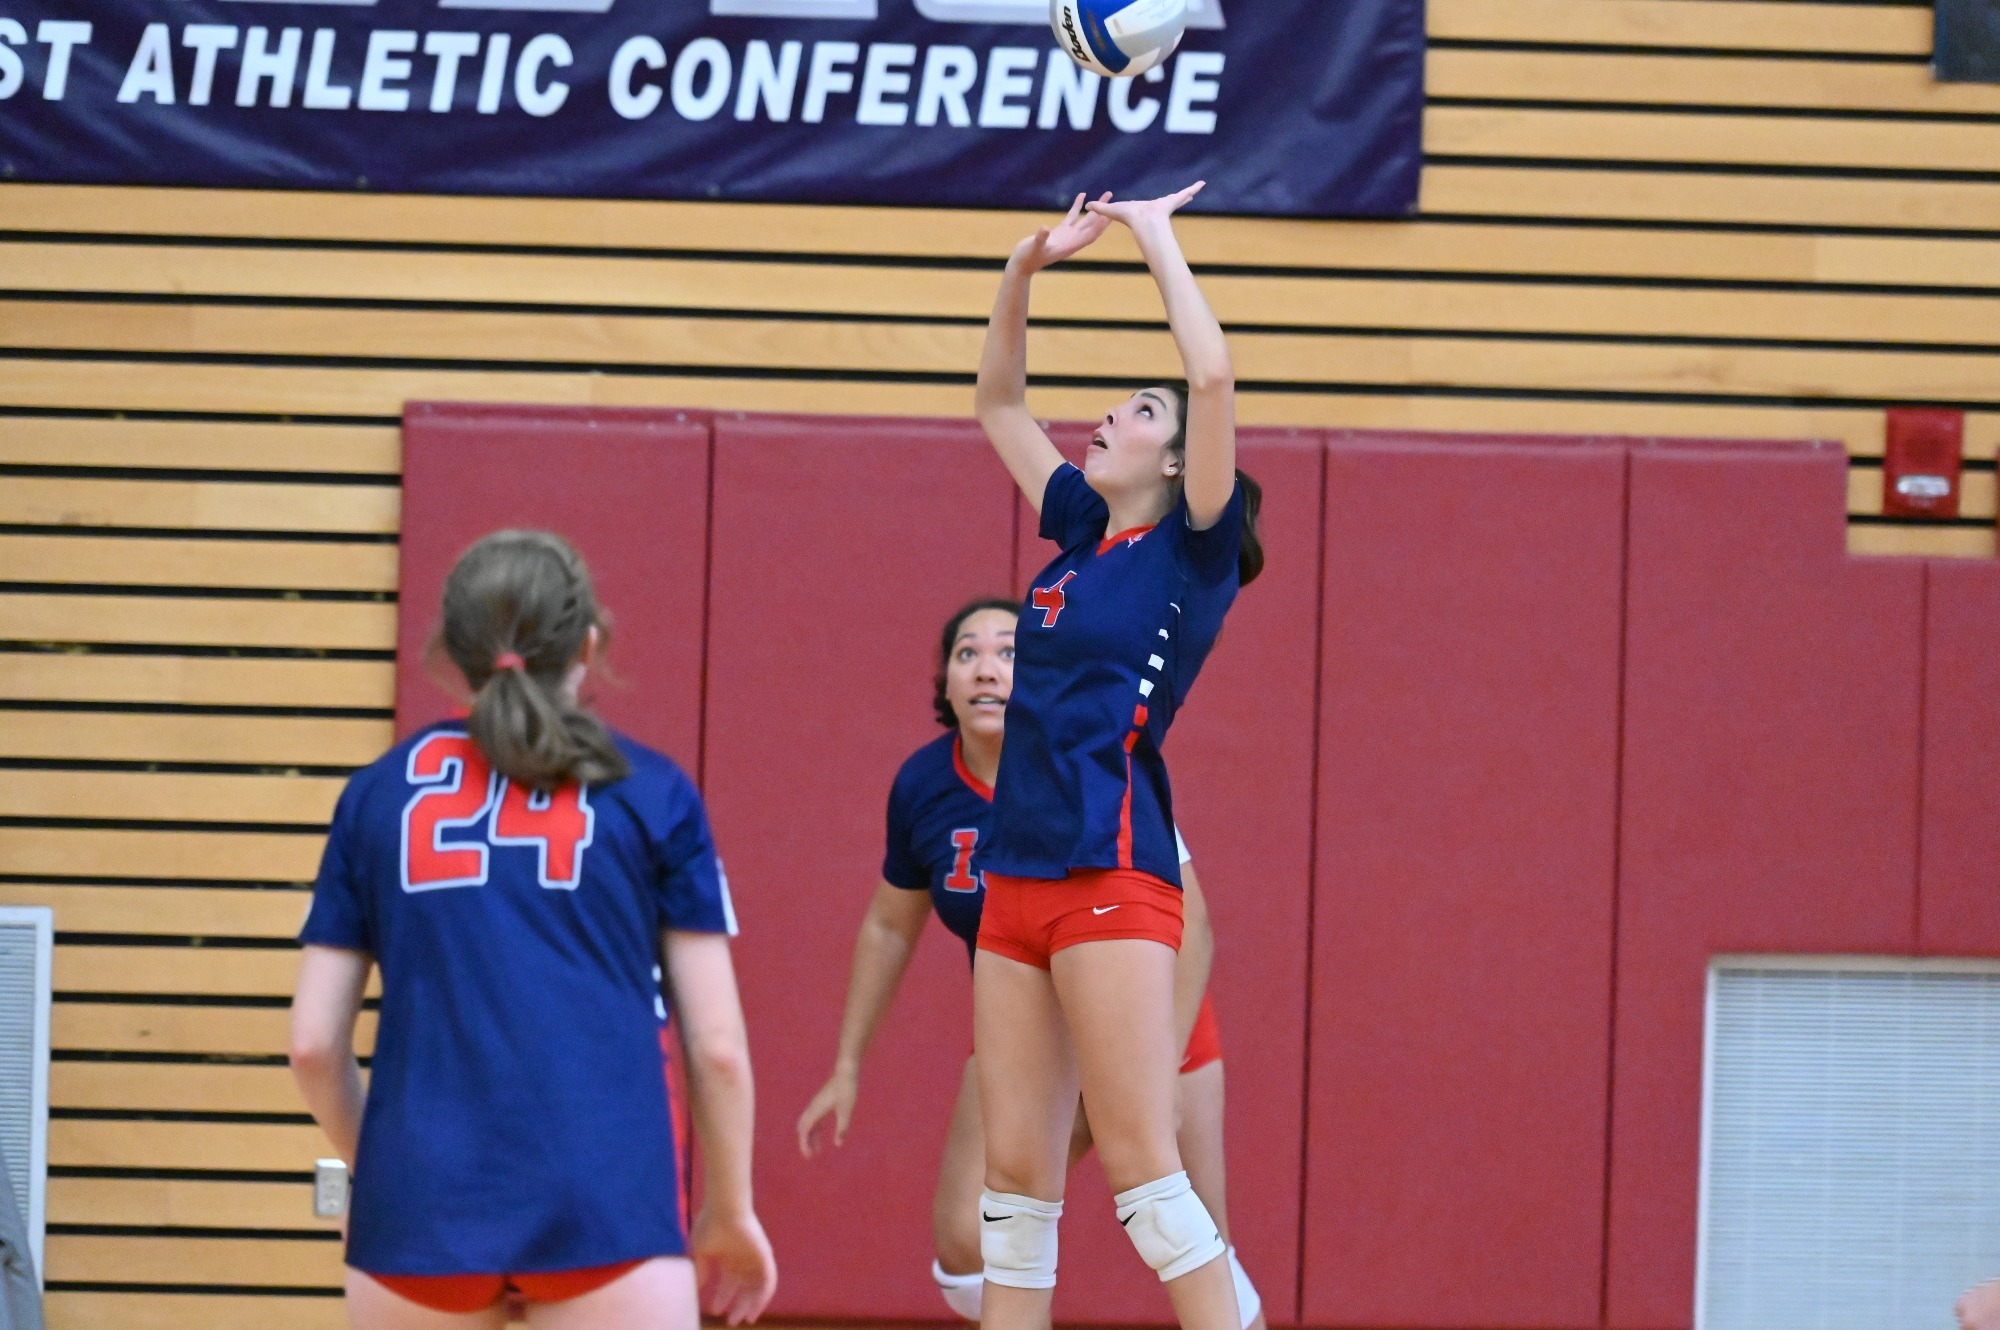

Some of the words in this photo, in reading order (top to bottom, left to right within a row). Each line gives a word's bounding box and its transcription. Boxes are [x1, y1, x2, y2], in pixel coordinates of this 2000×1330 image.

[116, 22, 574, 118] ATHLETIC
[608, 35, 1227, 134] CONFERENCE
[1032, 570, 1077, 628] 4
[402, 730, 595, 893] 24
[944, 828, 987, 893] 1
